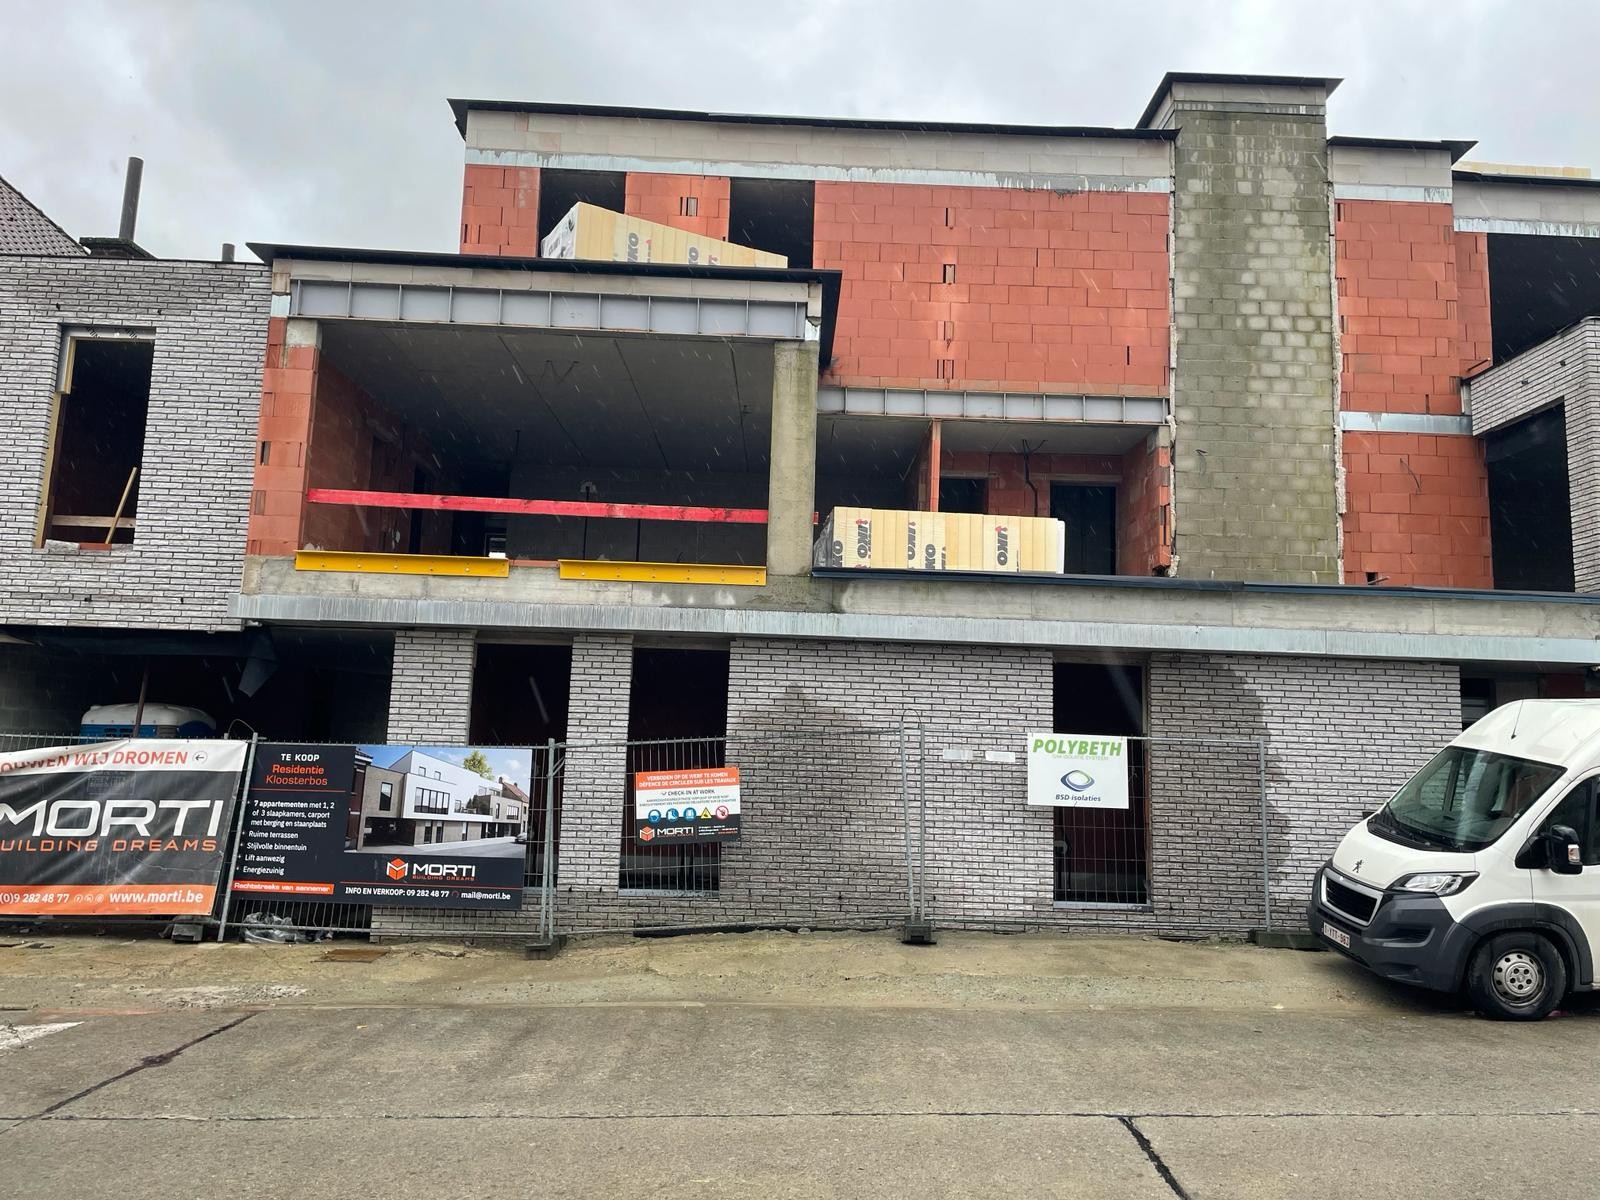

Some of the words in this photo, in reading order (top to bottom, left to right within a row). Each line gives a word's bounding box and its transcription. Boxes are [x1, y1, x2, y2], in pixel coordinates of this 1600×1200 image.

[1032, 739, 1122, 756] POLYBETH
[73, 752, 109, 766] WIJ
[112, 751, 188, 765] DROMEN
[272, 764, 324, 775] Residentie
[266, 775, 328, 786] Kloosterbos
[0, 800, 224, 837] MORTI
[294, 820, 327, 829] staanplaats
[657, 827, 693, 835] MORTI
[113, 840, 217, 851] DREAMS
[243, 866, 284, 875] Energiezuinig
[413, 864, 475, 877] MORTI
[22, 893, 40, 903] 282
[42, 893, 55, 903] 48
[56, 893, 70, 903] 77
[110, 890, 203, 903] www.morti.be
